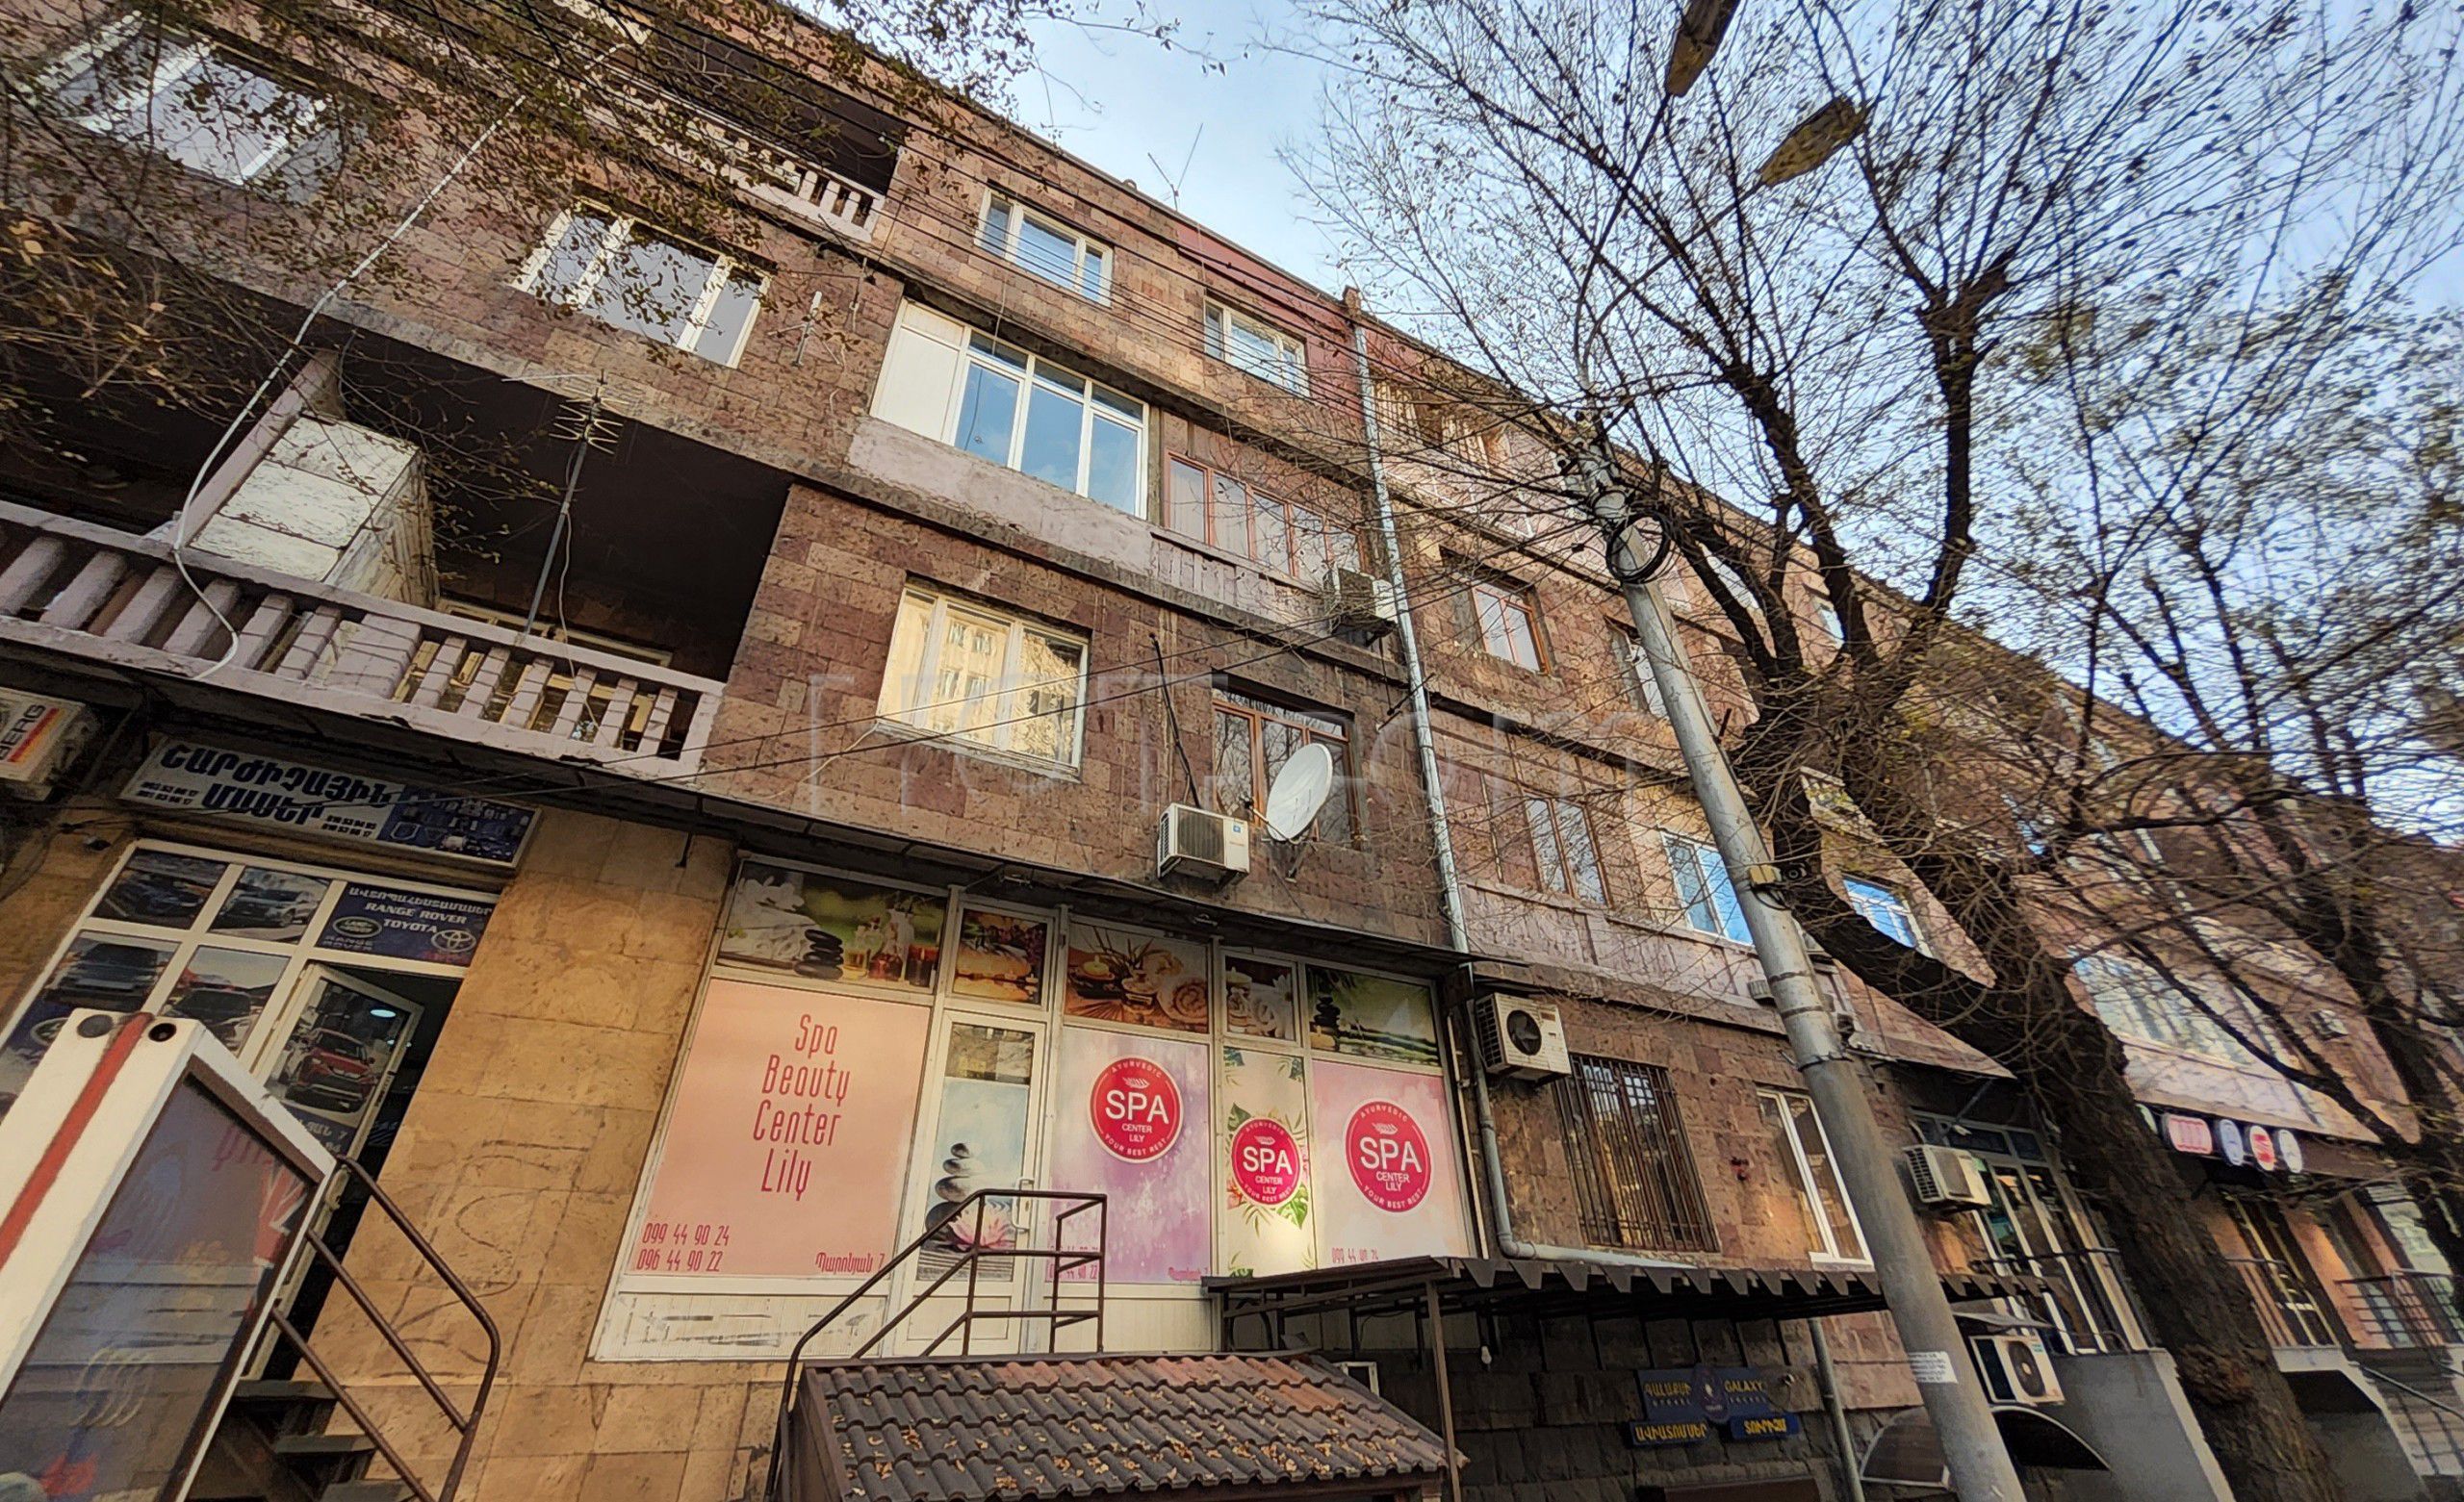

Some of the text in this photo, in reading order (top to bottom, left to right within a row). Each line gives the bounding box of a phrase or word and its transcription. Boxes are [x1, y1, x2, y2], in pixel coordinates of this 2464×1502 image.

[160, 744, 400, 808] ՇԱՐԺԻՉԱՅԻՆ
[201, 783, 325, 826] ՄԱՍԵՐ
[365, 903, 467, 924] RANGE ROVER
[384, 918, 438, 933] TOYOTA
[795, 1014, 837, 1058] Spa
[761, 1054, 850, 1107] Beauty
[1112, 1061, 1162, 1078] AYURVEDIC
[1105, 1089, 1169, 1124] SPA
[1360, 1105, 1408, 1122] AYURVEDIC
[753, 1099, 841, 1146] Center
[1121, 1123, 1152, 1133] CENTER
[1105, 1133, 1125, 1152] YOUR
[1243, 1146, 1293, 1175] SPA
[1360, 1136, 1423, 1173] SPA
[761, 1148, 811, 1201] Lily
[1255, 1176, 1283, 1184] CENTER
[1376, 1171, 1410, 1184] CENTER
[1364, 1185, 1385, 1205] YOUR
[642, 1223, 730, 1246] 099 44 90 24
[636, 1249, 723, 1272] 096 44 90 22
[1724, 1380, 1763, 1392] GALAXY
